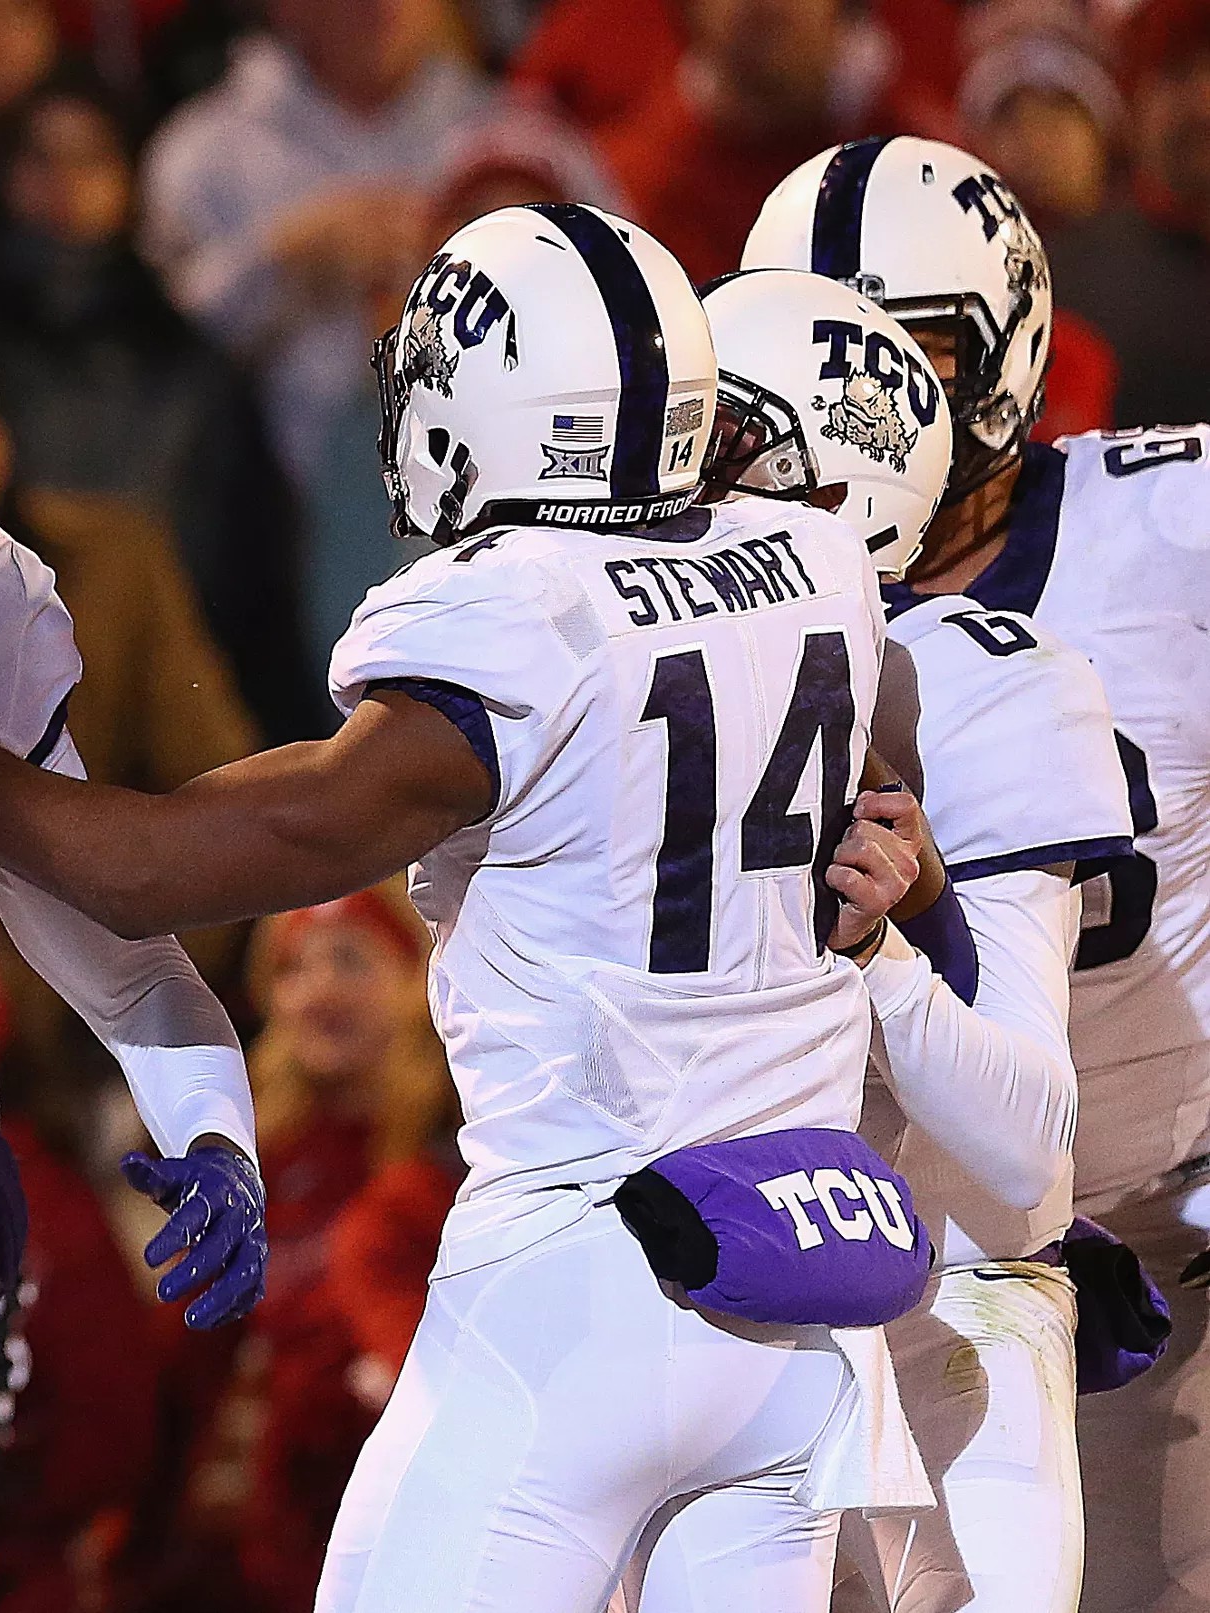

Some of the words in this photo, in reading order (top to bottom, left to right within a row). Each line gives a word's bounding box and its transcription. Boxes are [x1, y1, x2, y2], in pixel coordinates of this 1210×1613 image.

[812, 319, 939, 428] TCU
[545, 449, 605, 478] XII
[668, 435, 695, 472] 14
[536, 504, 644, 524] HORNED
[605, 530, 816, 626] STEWART
[940, 610, 1038, 656] 6
[638, 630, 856, 974] 14
[754, 1167, 915, 1252] TCU
